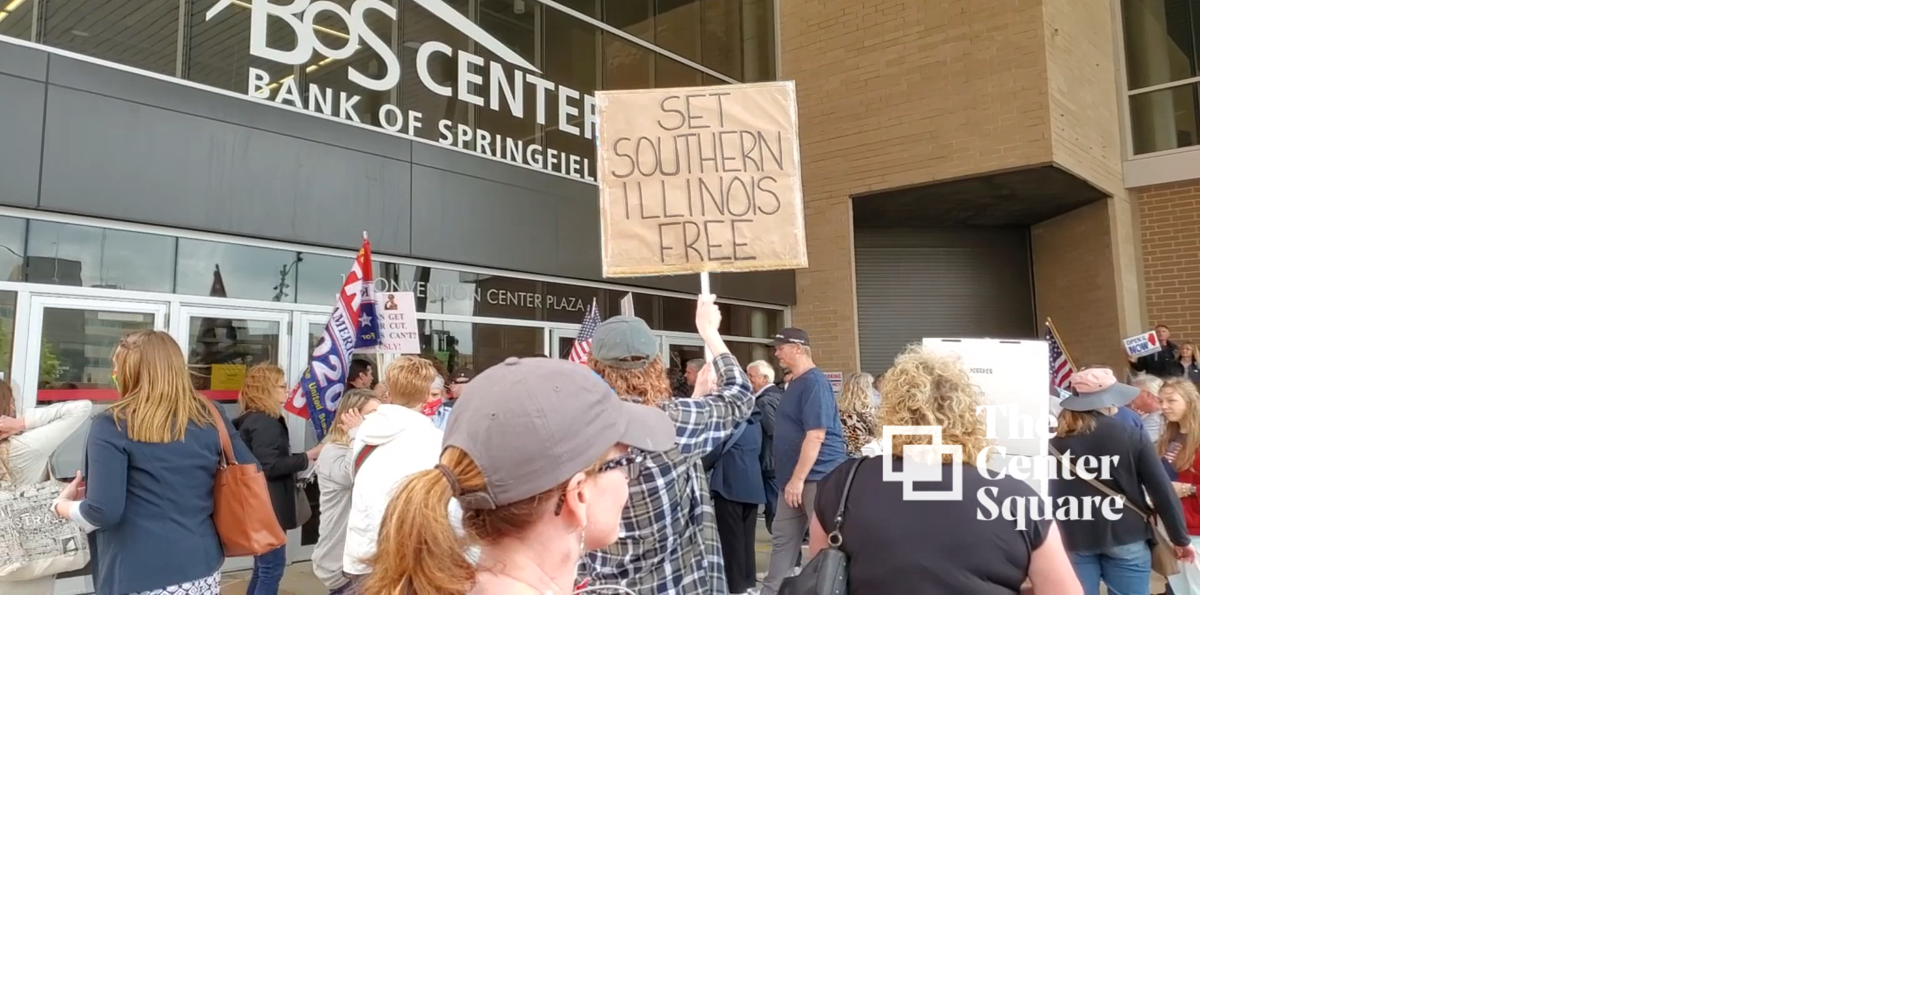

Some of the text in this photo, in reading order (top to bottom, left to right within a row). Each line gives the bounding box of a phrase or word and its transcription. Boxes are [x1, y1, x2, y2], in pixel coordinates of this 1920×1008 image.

[248, 67, 595, 182] BANK OF SPRINGFIEL
[657, 92, 731, 132] SET
[611, 130, 784, 179] SOUTHERN
[622, 175, 782, 220] ILLINOIS
[658, 219, 757, 263] FREE
[373, 277, 482, 303] ONVENTION
[486, 288, 543, 308] CENTER
[546, 295, 585, 312] PLAZA
[331, 306, 354, 361] AMERIC
[388, 313, 404, 321] GET
[1128, 342, 1149, 354] NOW
[308, 381, 324, 411] United
